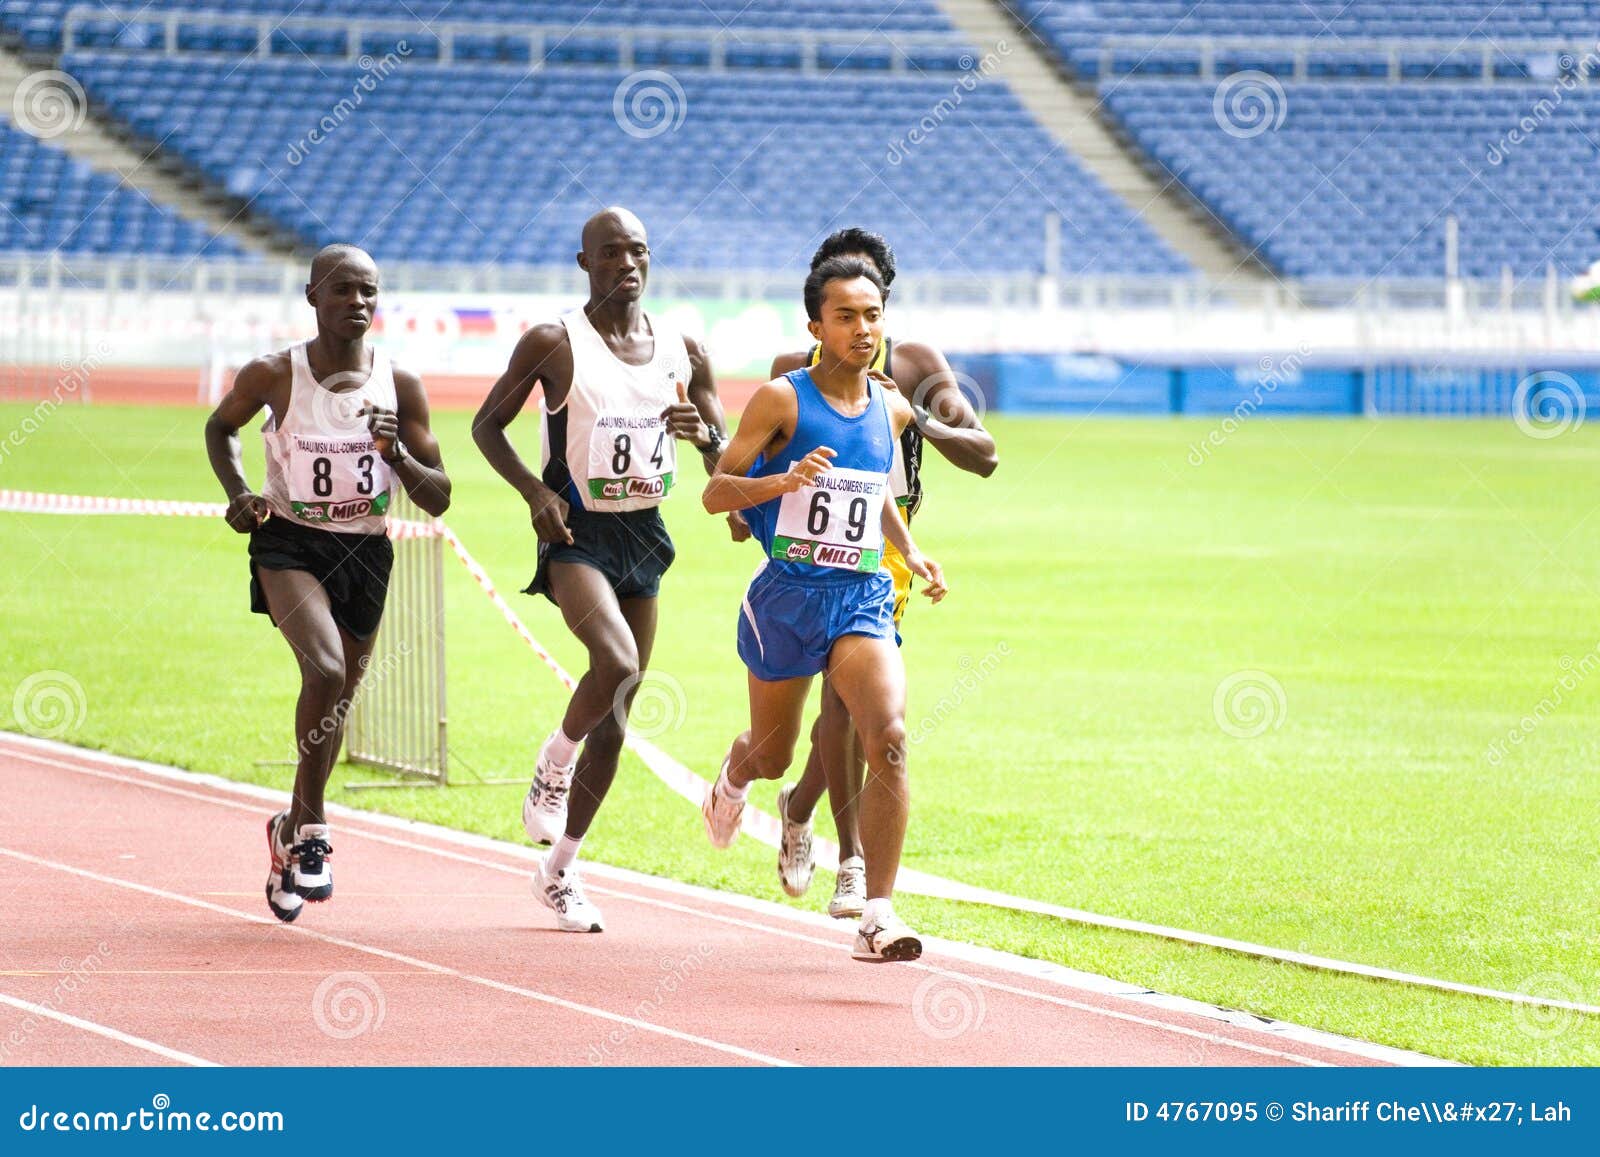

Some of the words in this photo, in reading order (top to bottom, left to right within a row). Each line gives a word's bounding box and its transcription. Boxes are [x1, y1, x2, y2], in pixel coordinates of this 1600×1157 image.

[328, 442, 366, 454] ALL-COMERS
[628, 479, 663, 495] MILO
[826, 478, 863, 494] ALL-COMERS
[331, 501, 370, 519] MILO
[788, 546, 809, 556] MILO
[816, 546, 861, 565] MILO
